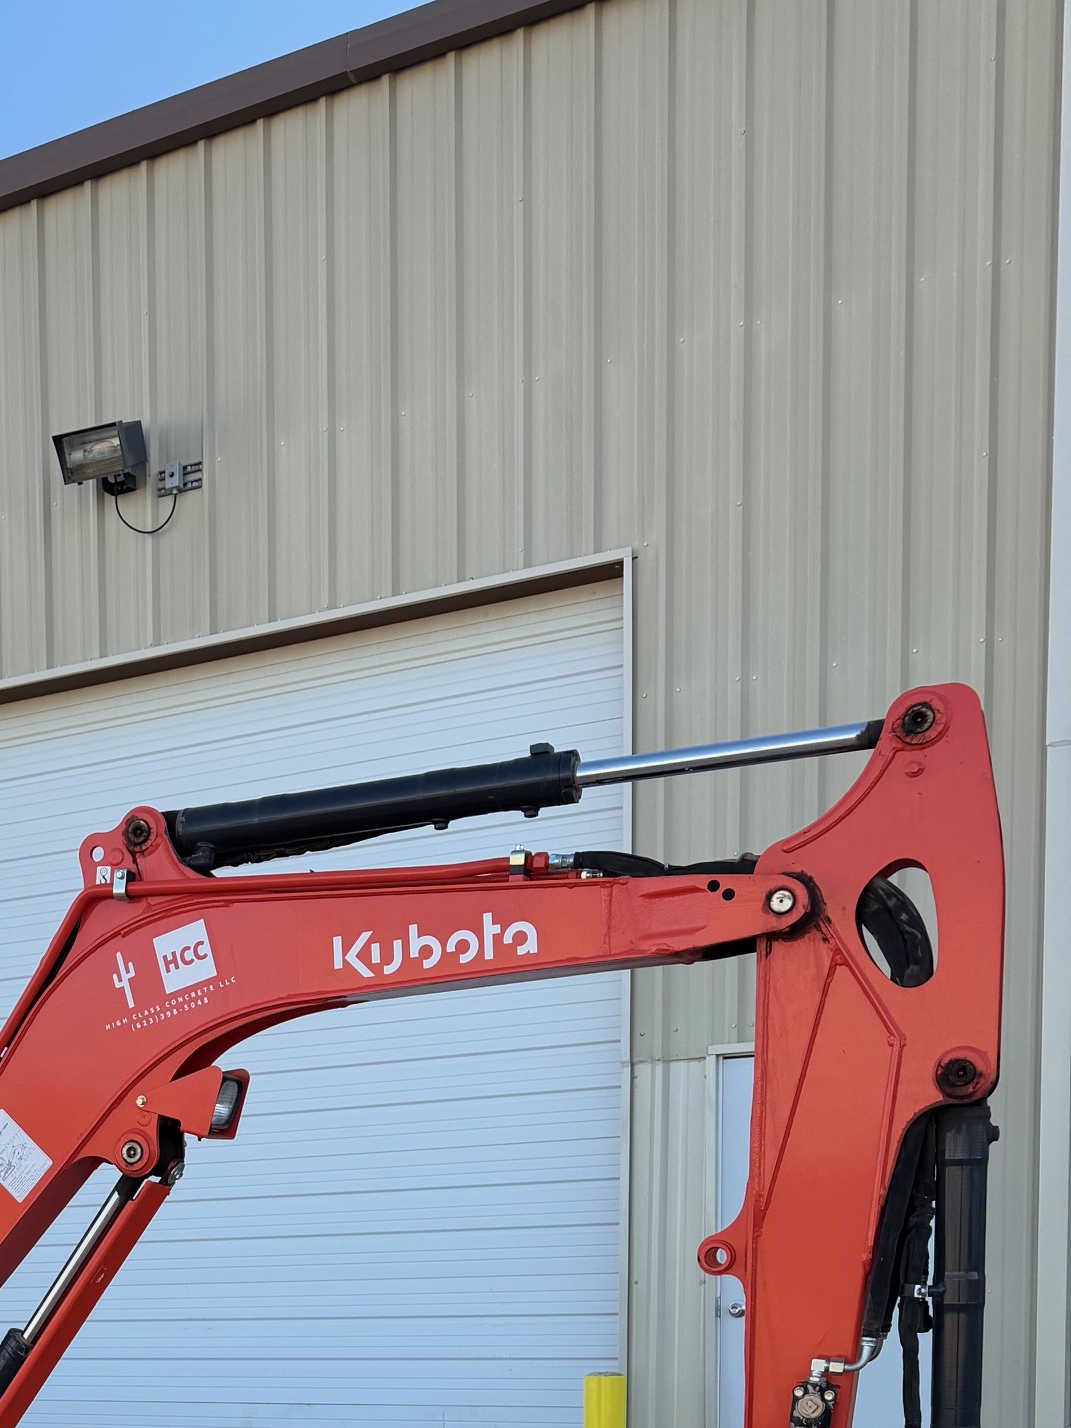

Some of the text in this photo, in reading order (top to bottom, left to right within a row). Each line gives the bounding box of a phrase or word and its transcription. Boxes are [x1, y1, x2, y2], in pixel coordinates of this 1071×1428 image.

[162, 940, 208, 974] HCC
[332, 912, 538, 978] Kubota
[105, 976, 236, 1031] HIGH CLASS CONCRETE LLC
[131, 997, 209, 1031] (623)398-5048
